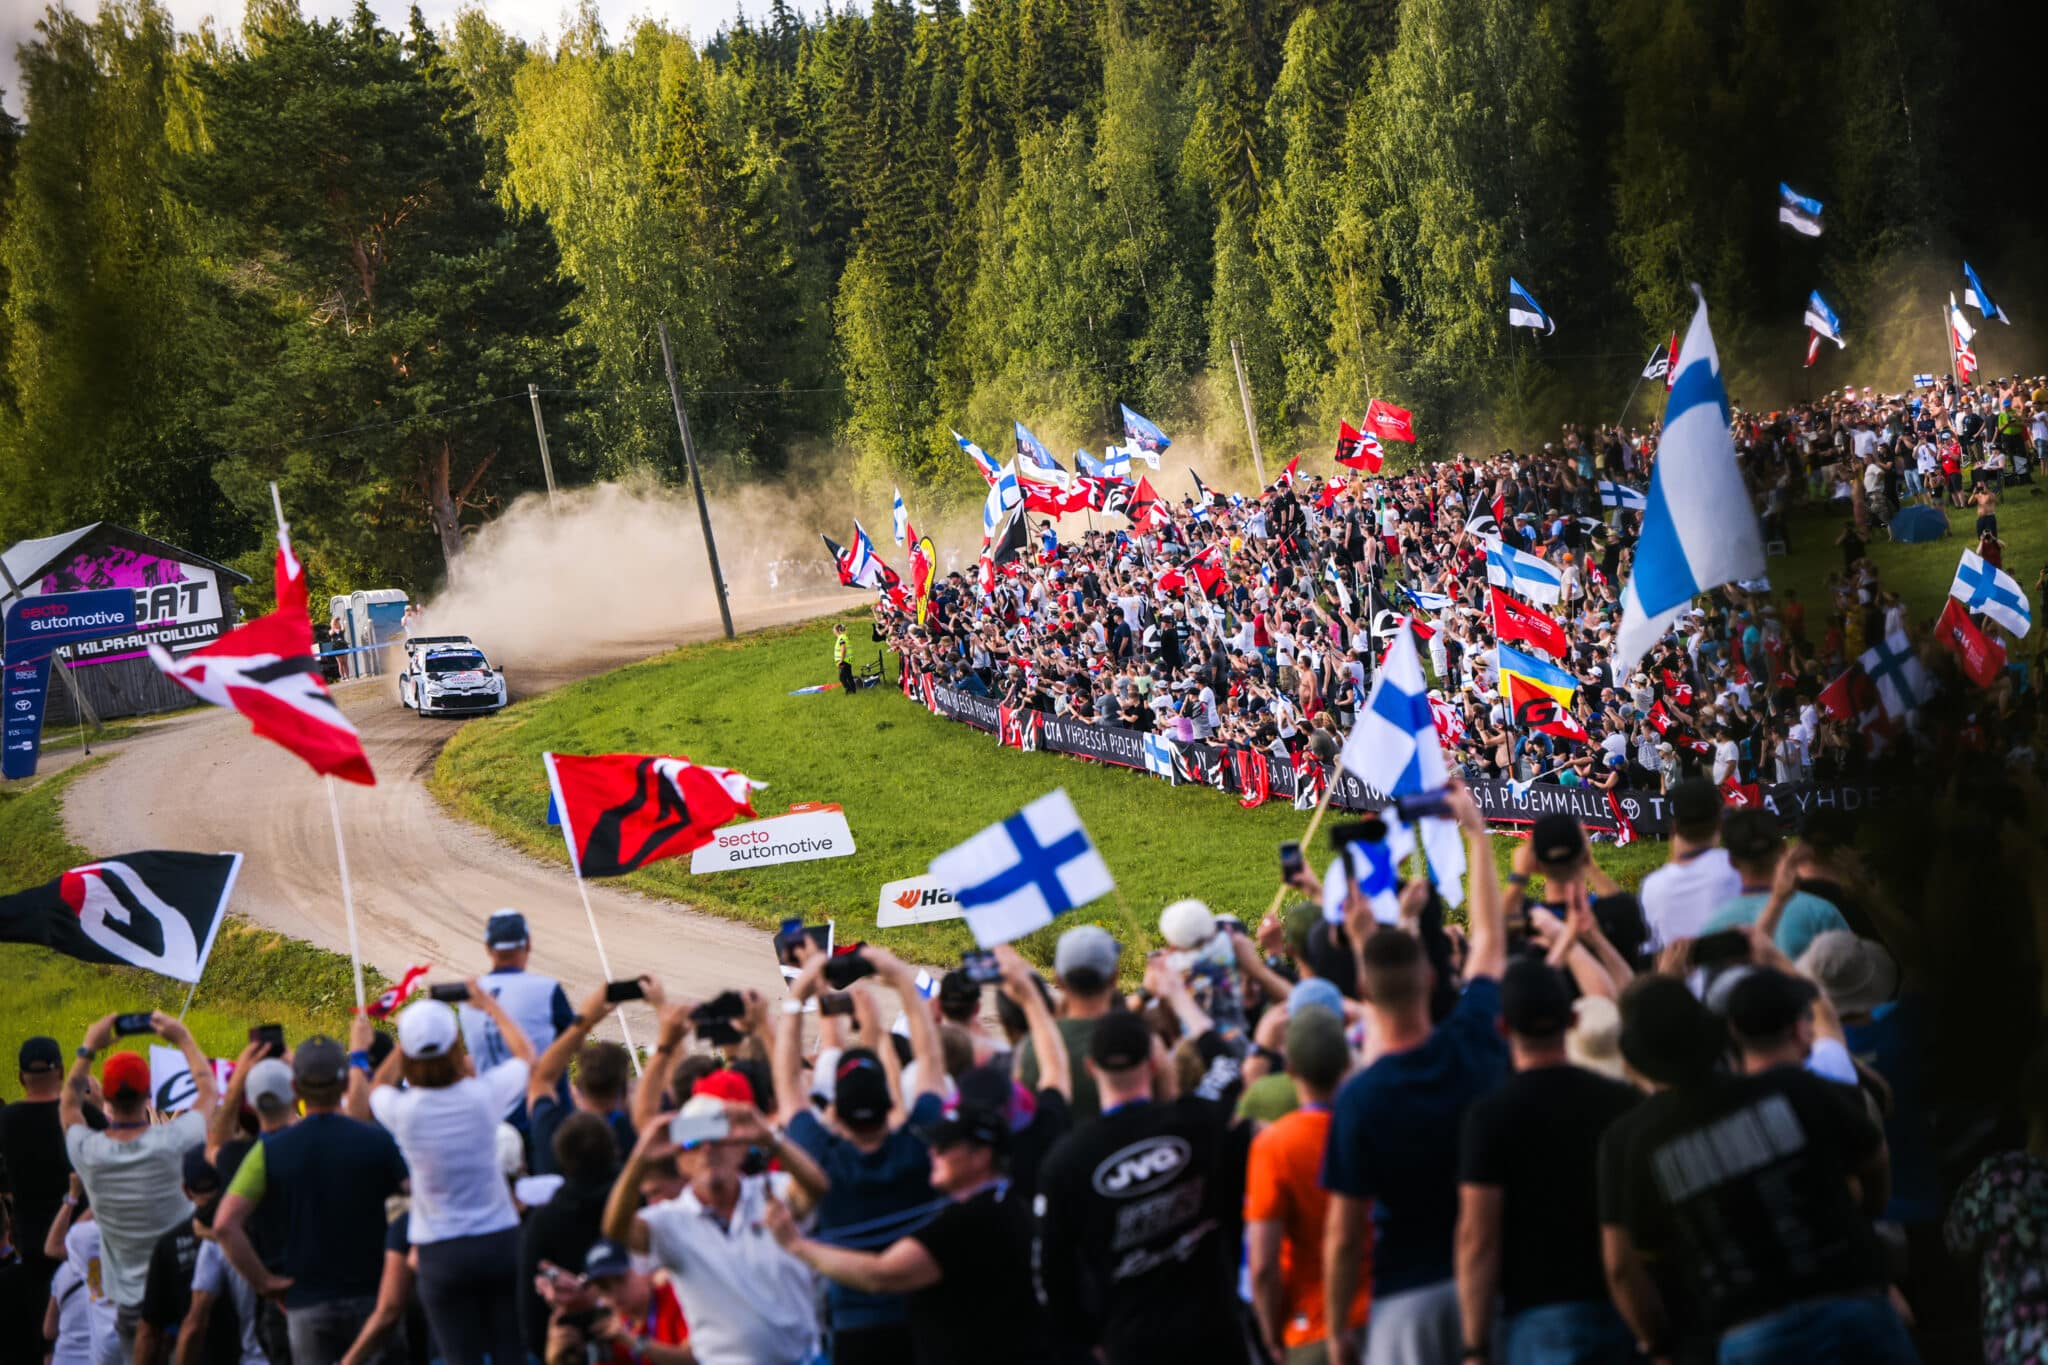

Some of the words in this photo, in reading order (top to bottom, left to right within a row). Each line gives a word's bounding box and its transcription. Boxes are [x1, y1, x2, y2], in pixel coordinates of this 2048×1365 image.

[20, 603, 69, 619] secto
[30, 609, 125, 631] automotive
[78, 622, 219, 656] KILPA-AUTOILUUN
[1044, 720, 1063, 743] OTA
[718, 830, 770, 849] secto
[729, 837, 833, 862] automotive
